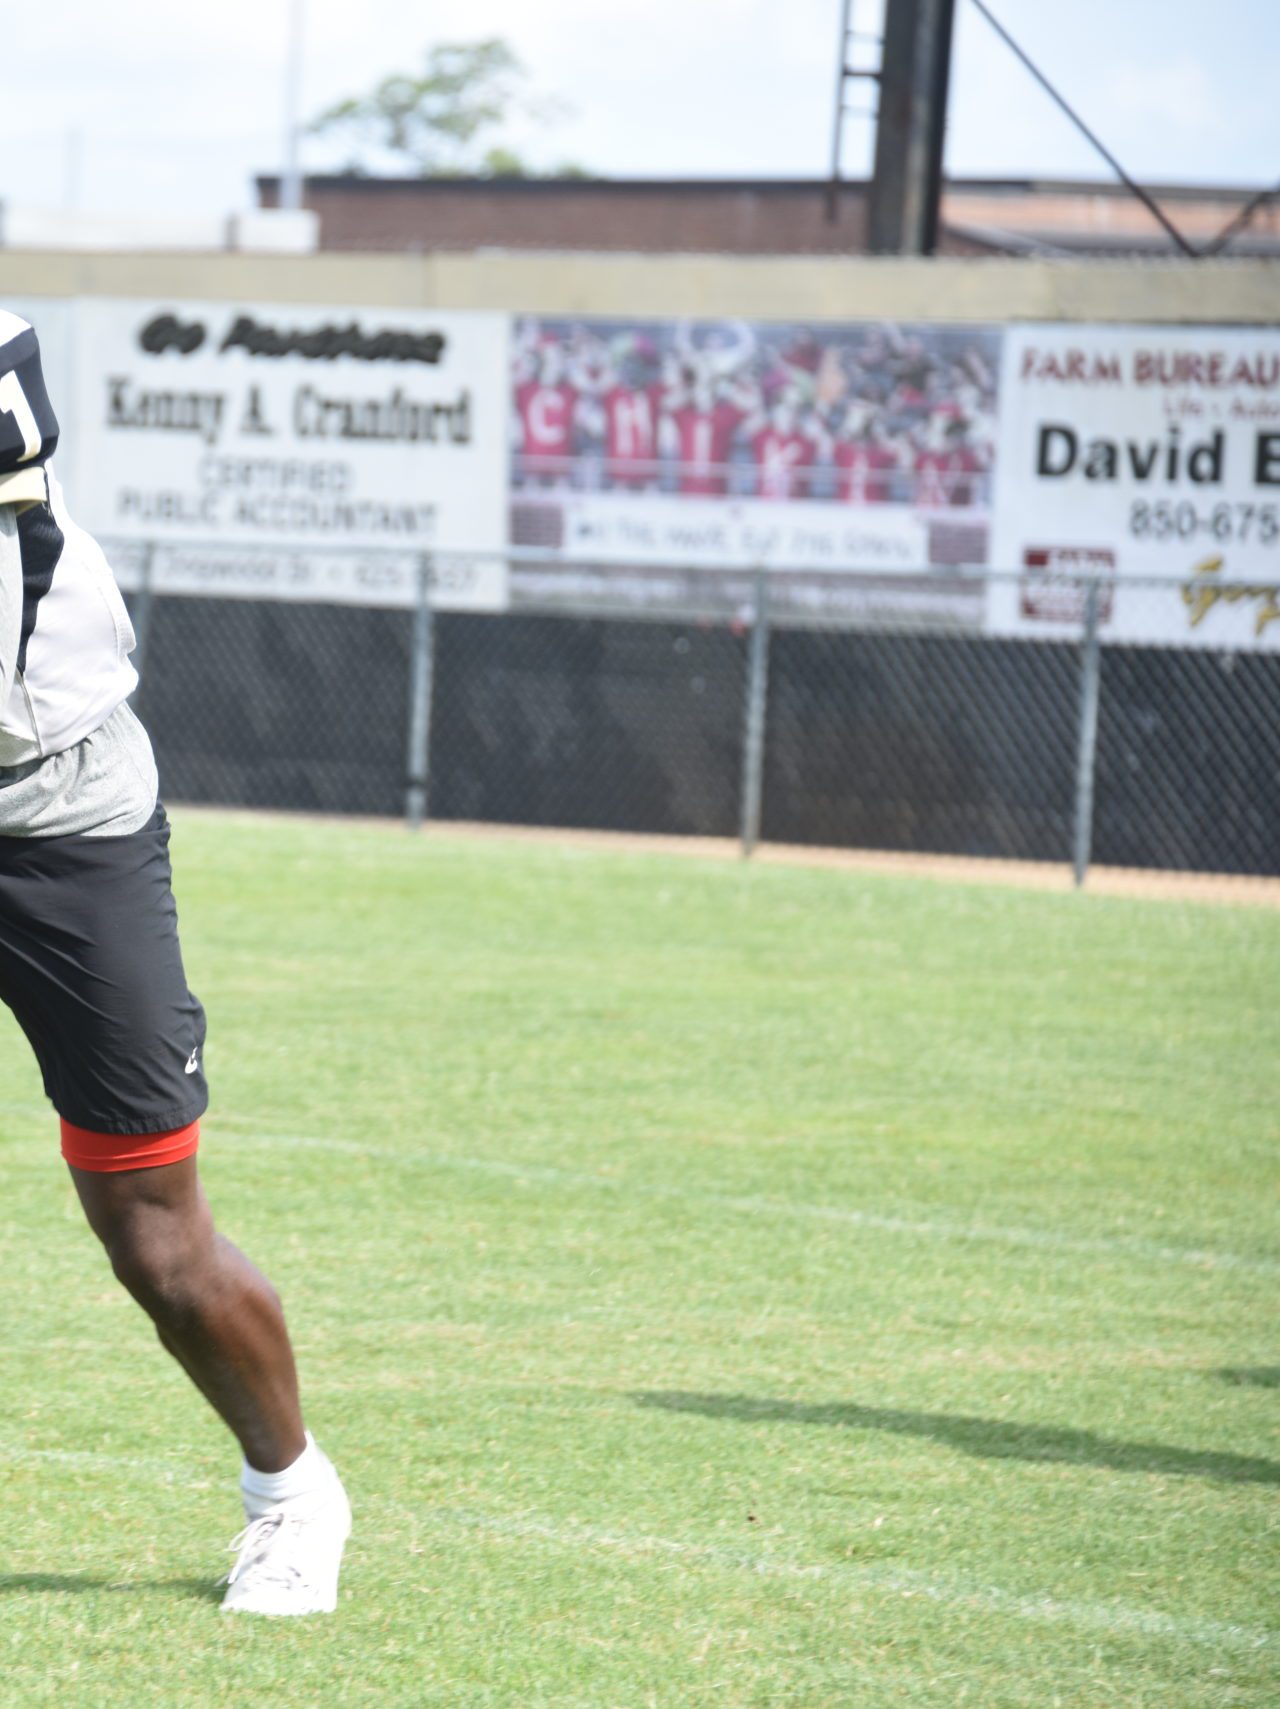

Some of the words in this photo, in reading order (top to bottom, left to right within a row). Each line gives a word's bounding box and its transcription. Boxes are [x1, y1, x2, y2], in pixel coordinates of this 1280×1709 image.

[1022, 349, 1122, 381] FARM
[1132, 351, 1280, 387] BUREAU
[107, 376, 225, 445] Kenny
[293, 384, 472, 445] Cranford
[198, 455, 353, 492] CERTIFIED
[1036, 421, 1225, 484] David
[118, 488, 218, 524] PUBLIC
[232, 497, 439, 535] ACCOUNTANT
